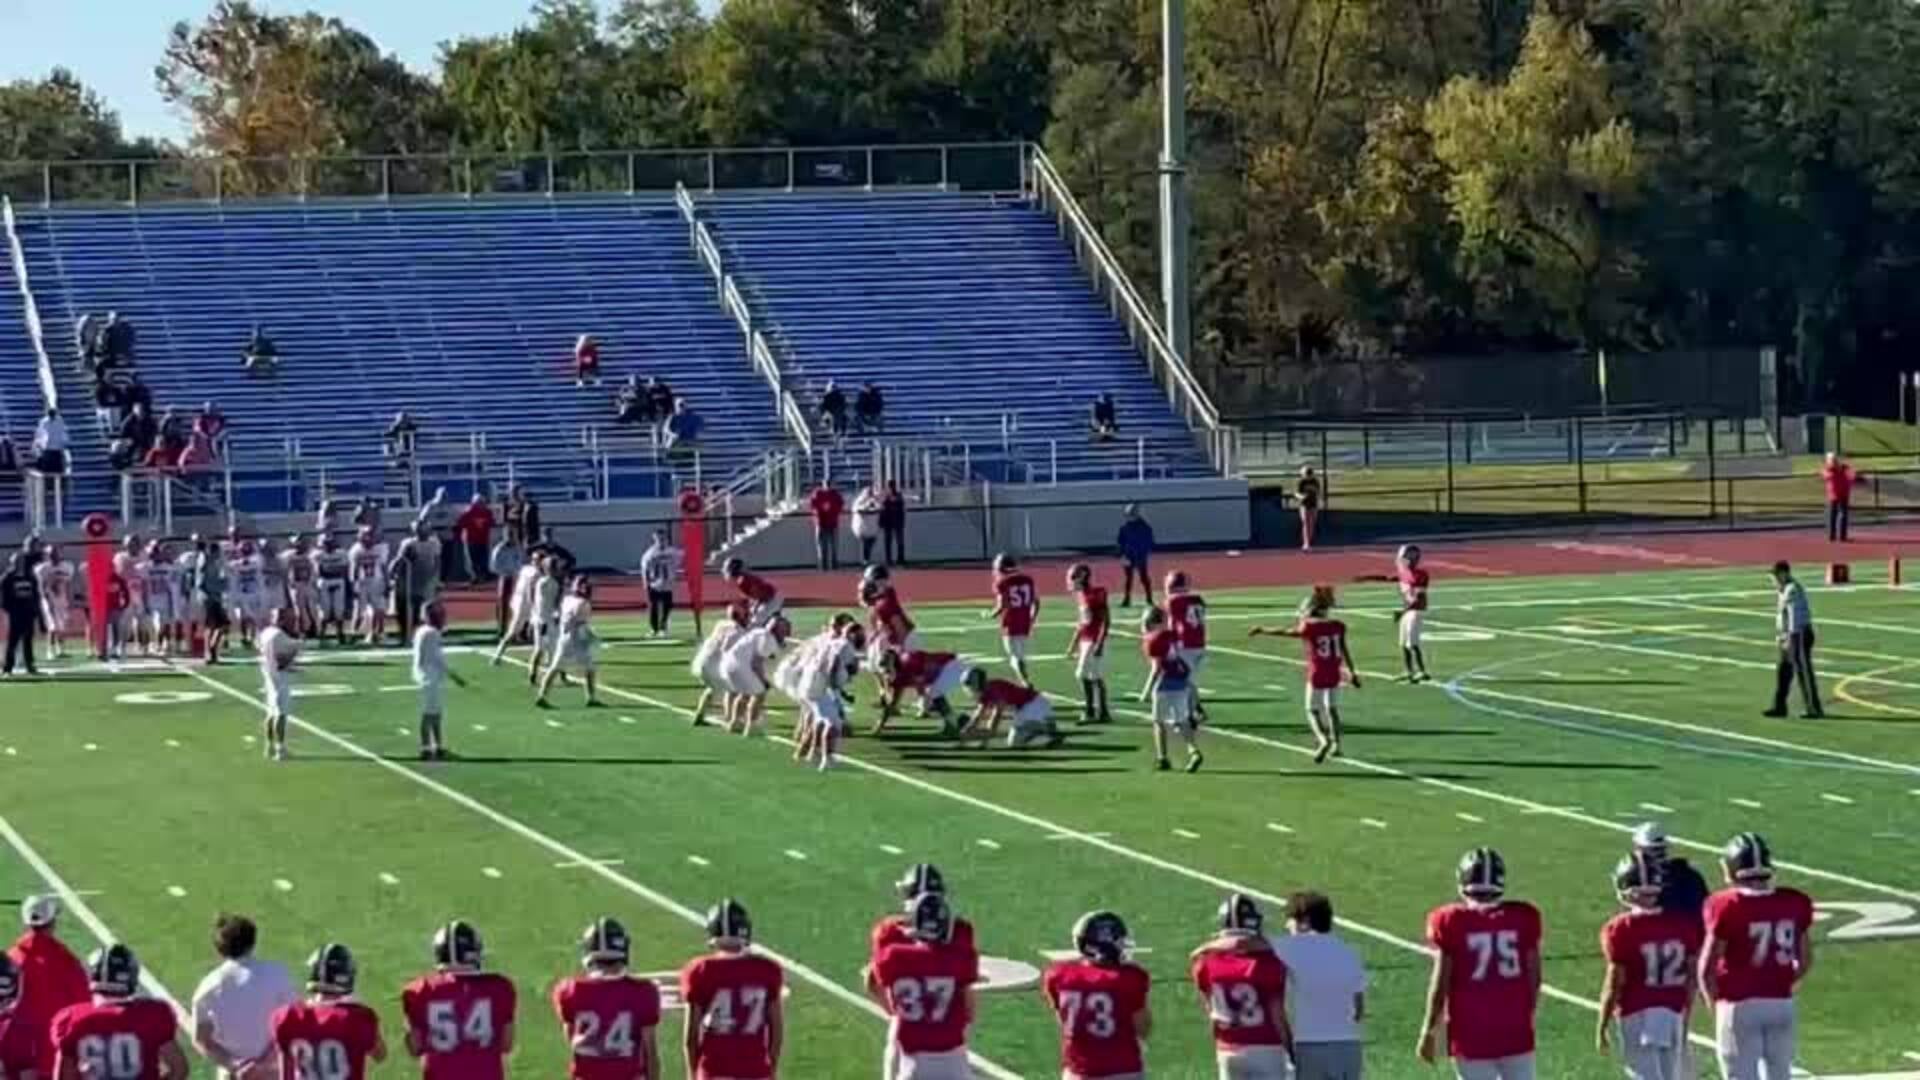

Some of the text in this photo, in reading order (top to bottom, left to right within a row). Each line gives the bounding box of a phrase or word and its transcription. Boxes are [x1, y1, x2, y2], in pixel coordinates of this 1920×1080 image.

[1317, 634, 1342, 658] 31
[1467, 929, 1522, 981] 75
[1638, 939, 1687, 987] 12
[702, 988, 768, 1034] 47
[893, 977, 955, 1022] 37
[1059, 989, 1116, 1038] 73
[427, 998, 494, 1052] 54
[571, 1011, 634, 1057] 24
